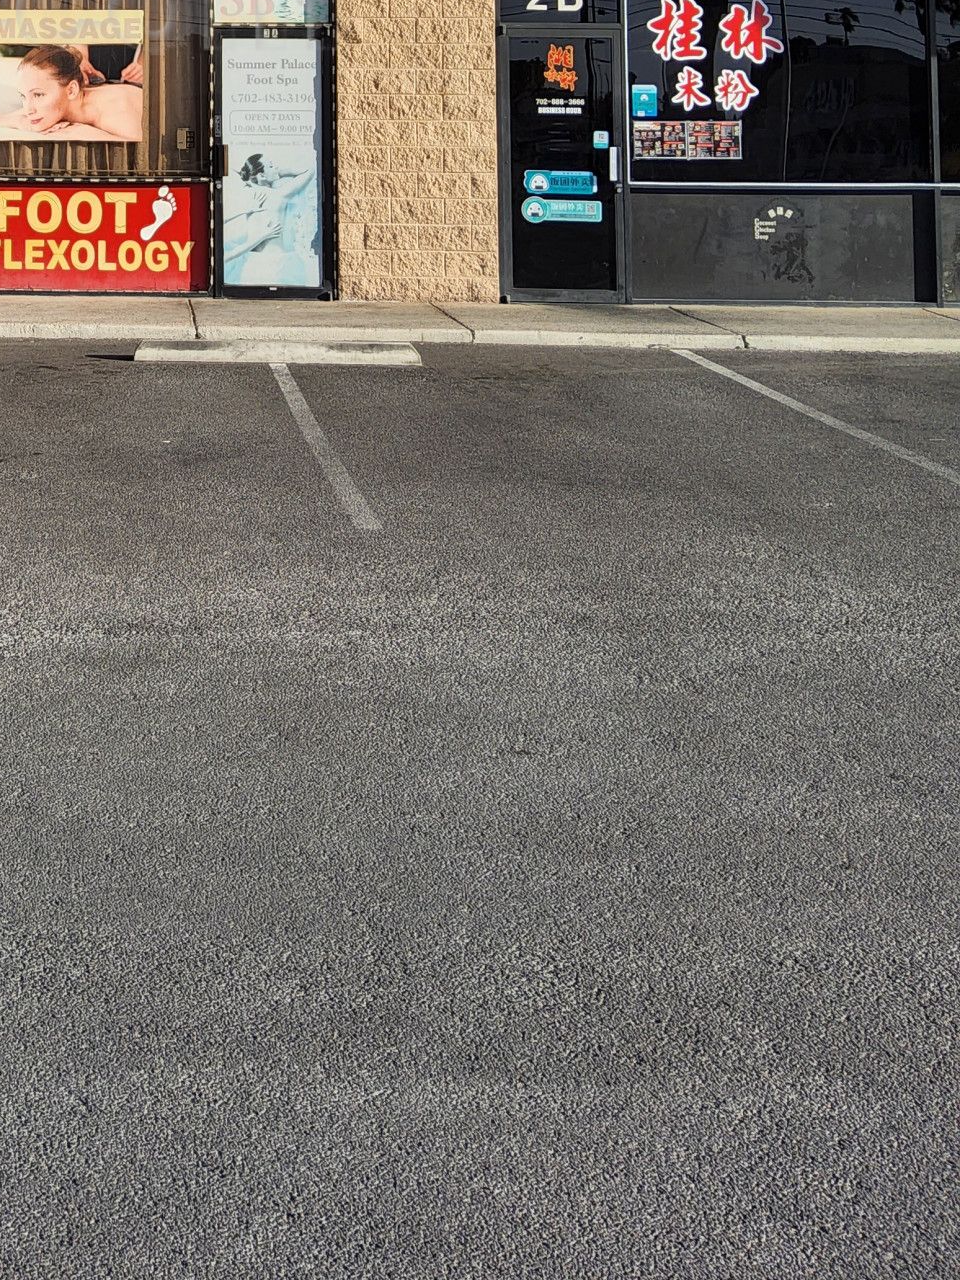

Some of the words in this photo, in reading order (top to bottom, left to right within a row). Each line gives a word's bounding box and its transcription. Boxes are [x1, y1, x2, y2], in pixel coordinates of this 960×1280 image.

[227, 58, 277, 69] Summer
[281, 58, 316, 70] Palace
[246, 74, 273, 85] Foot
[276, 74, 298, 86] Spa
[671, 65, 760, 111] 米粉
[244, 113, 269, 121] OPEN
[278, 113, 301, 121] DAYS
